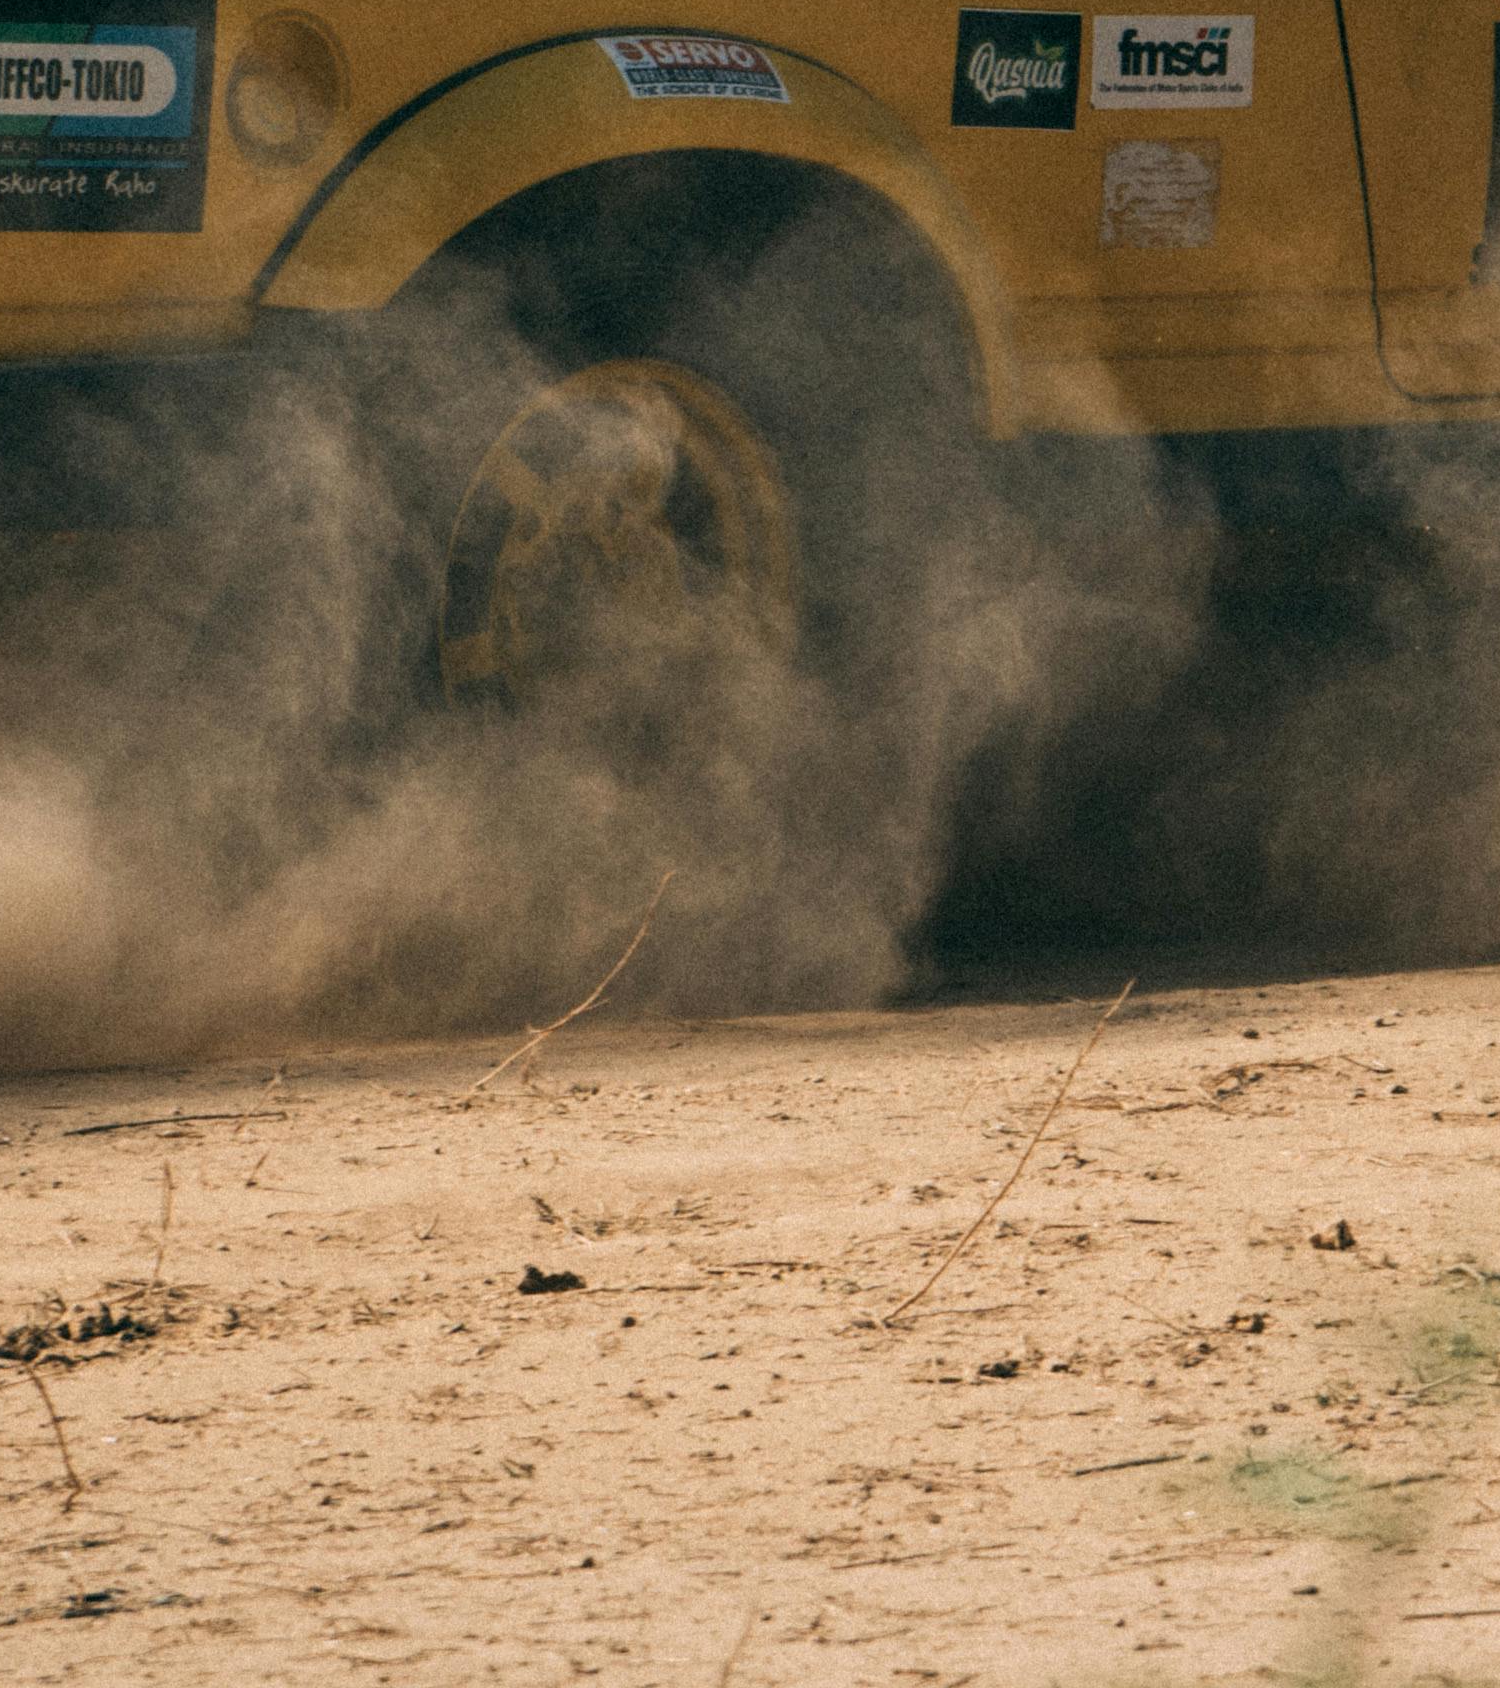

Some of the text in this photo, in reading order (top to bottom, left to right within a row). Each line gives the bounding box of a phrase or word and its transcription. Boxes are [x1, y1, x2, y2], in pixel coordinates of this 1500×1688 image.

[650, 40, 755, 67] SERVO
[1118, 28, 1231, 76] fmsci
[52, 141, 190, 156] INSURANCE
